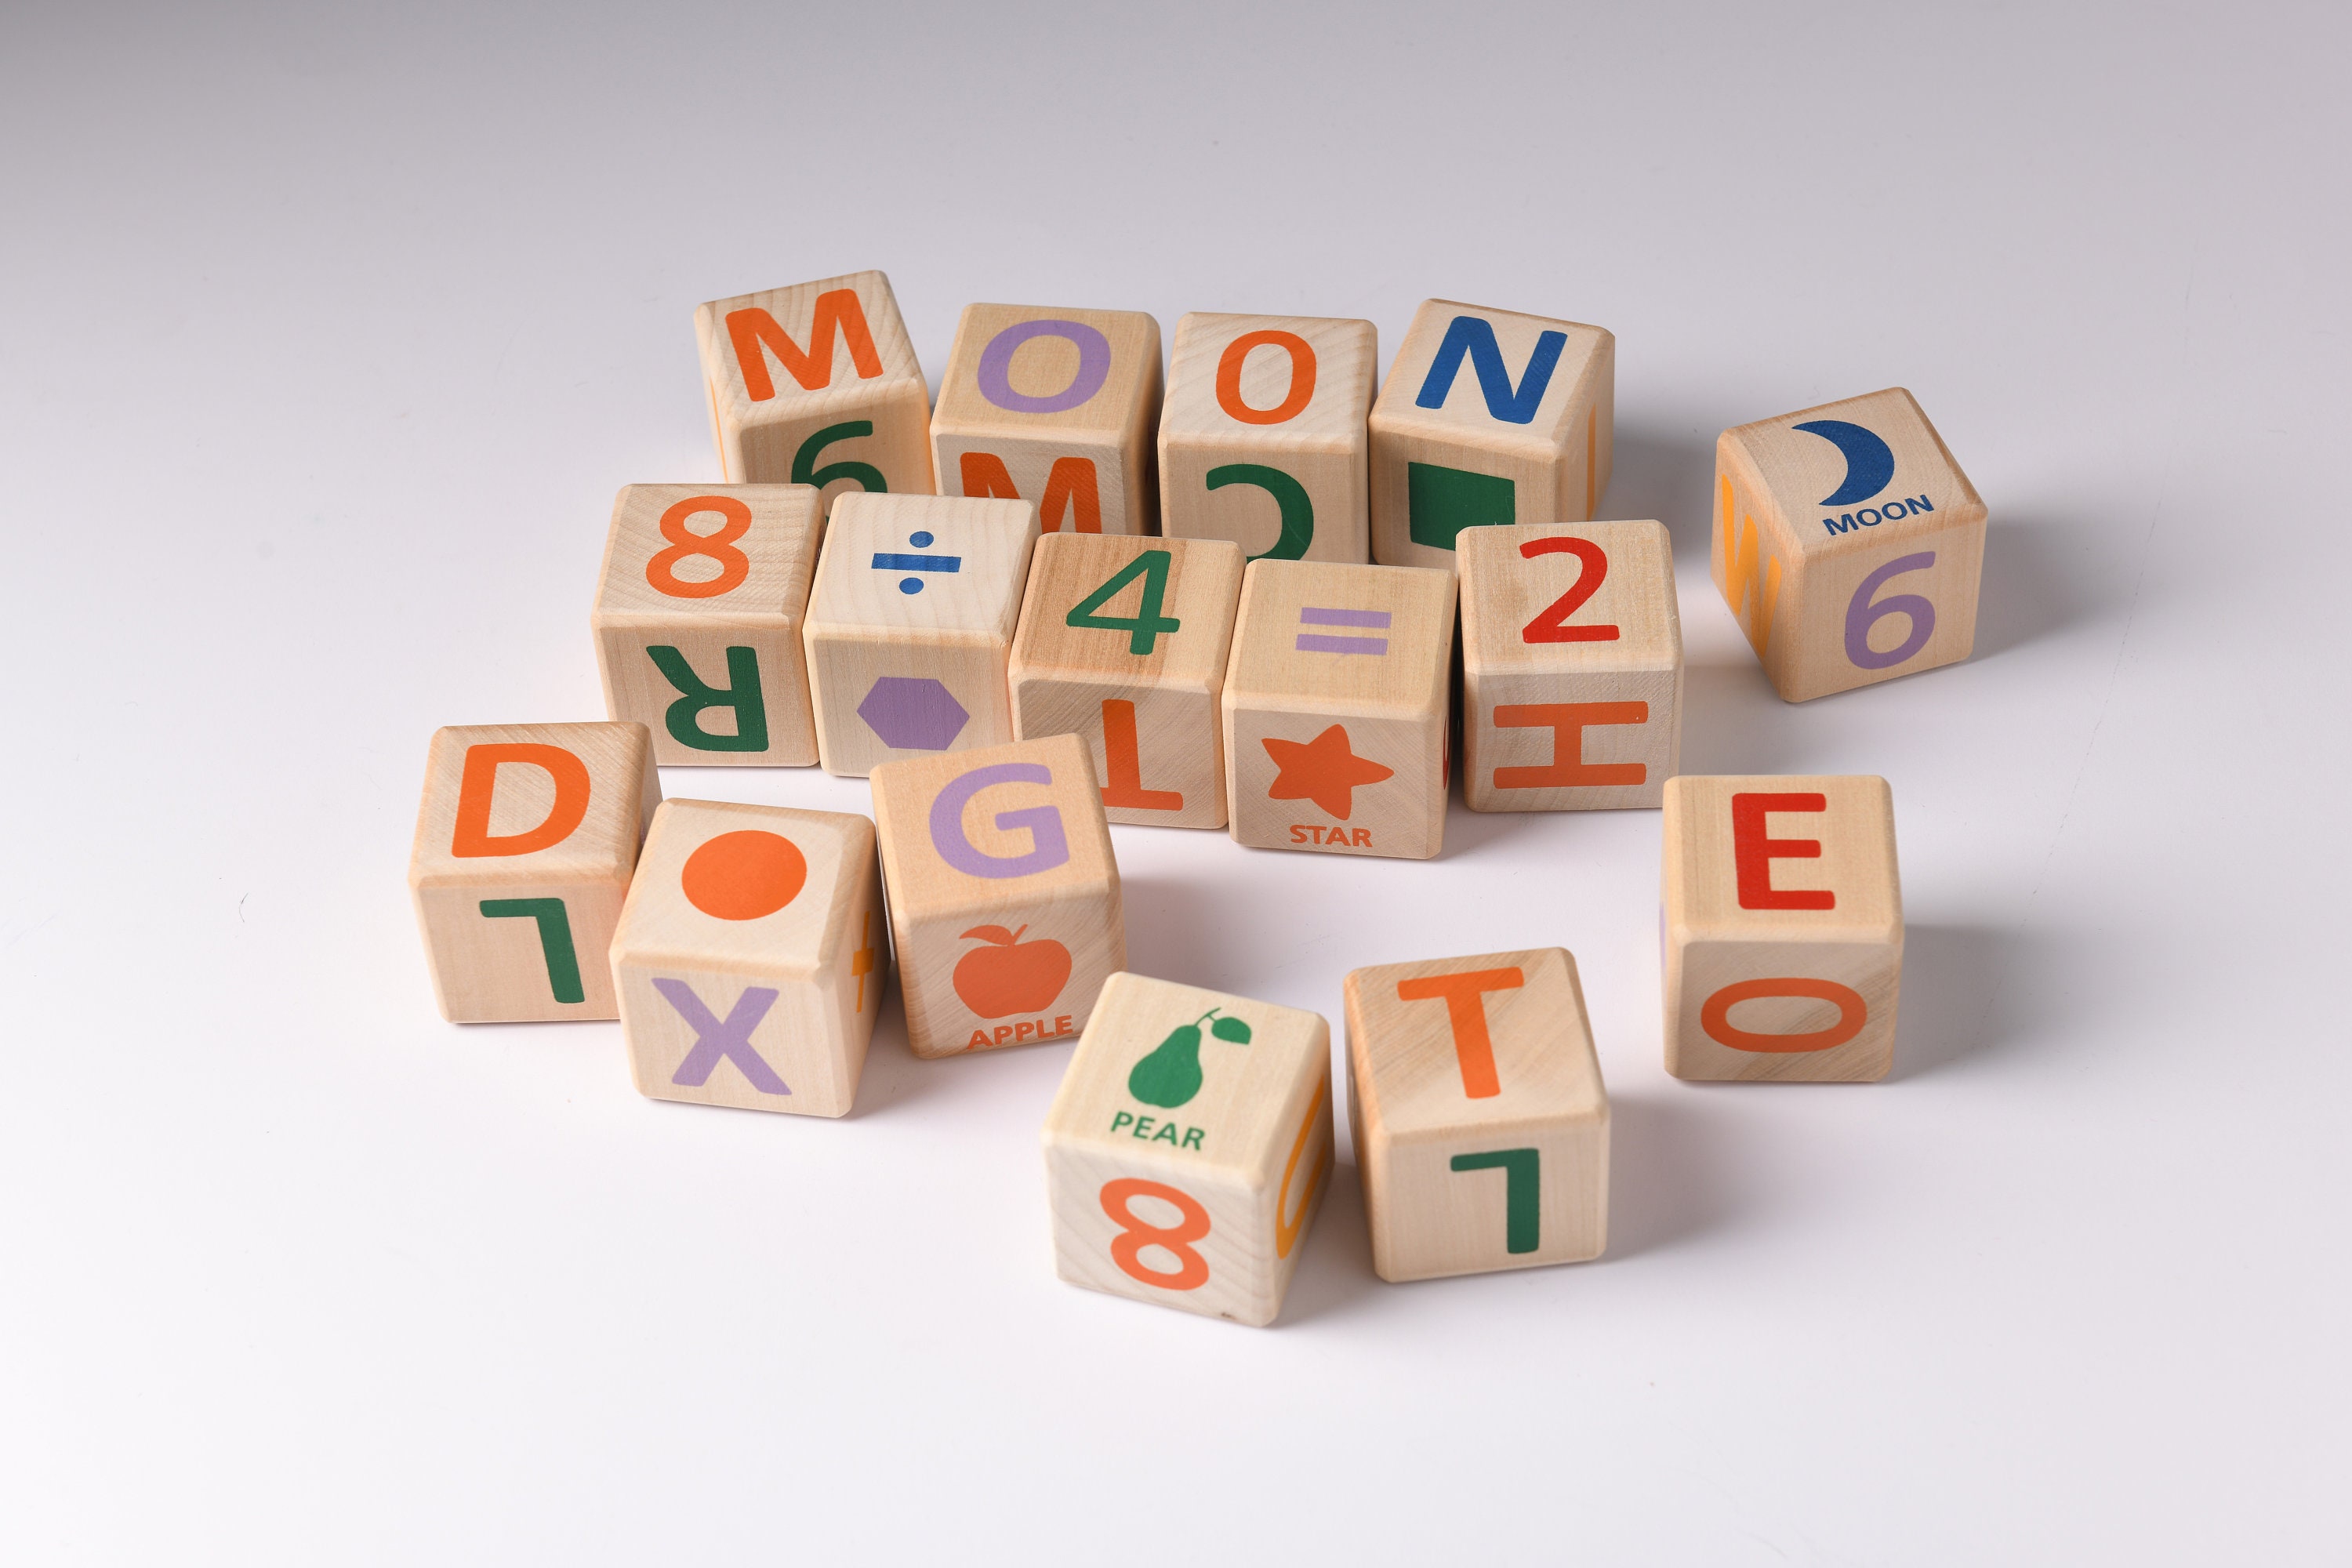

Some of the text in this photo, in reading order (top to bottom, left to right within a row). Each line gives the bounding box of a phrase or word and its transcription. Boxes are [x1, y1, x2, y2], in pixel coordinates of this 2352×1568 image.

[725, 288, 884, 402] M
[977, 319, 1111, 414] O
[1414, 315, 1568, 425] N
[1822, 494, 1934, 536] MOON
[644, 495, 753, 600] 8
[1065, 550, 1181, 656] 4
[1519, 535, 1621, 644] 2
[1844, 550, 1936, 670] 6
[647, 644, 768, 753] R
[451, 742, 592, 858] D
[928, 763, 1071, 879] G
[1289, 823, 1374, 848] STAR
[1731, 792, 1836, 911] E
[651, 976, 793, 1097] X
[966, 1014, 1074, 1051] APPLE
[1396, 966, 1526, 1100] T
[1109, 1110, 1207, 1152] PEAR
[1099, 1177, 1211, 1290] 8
